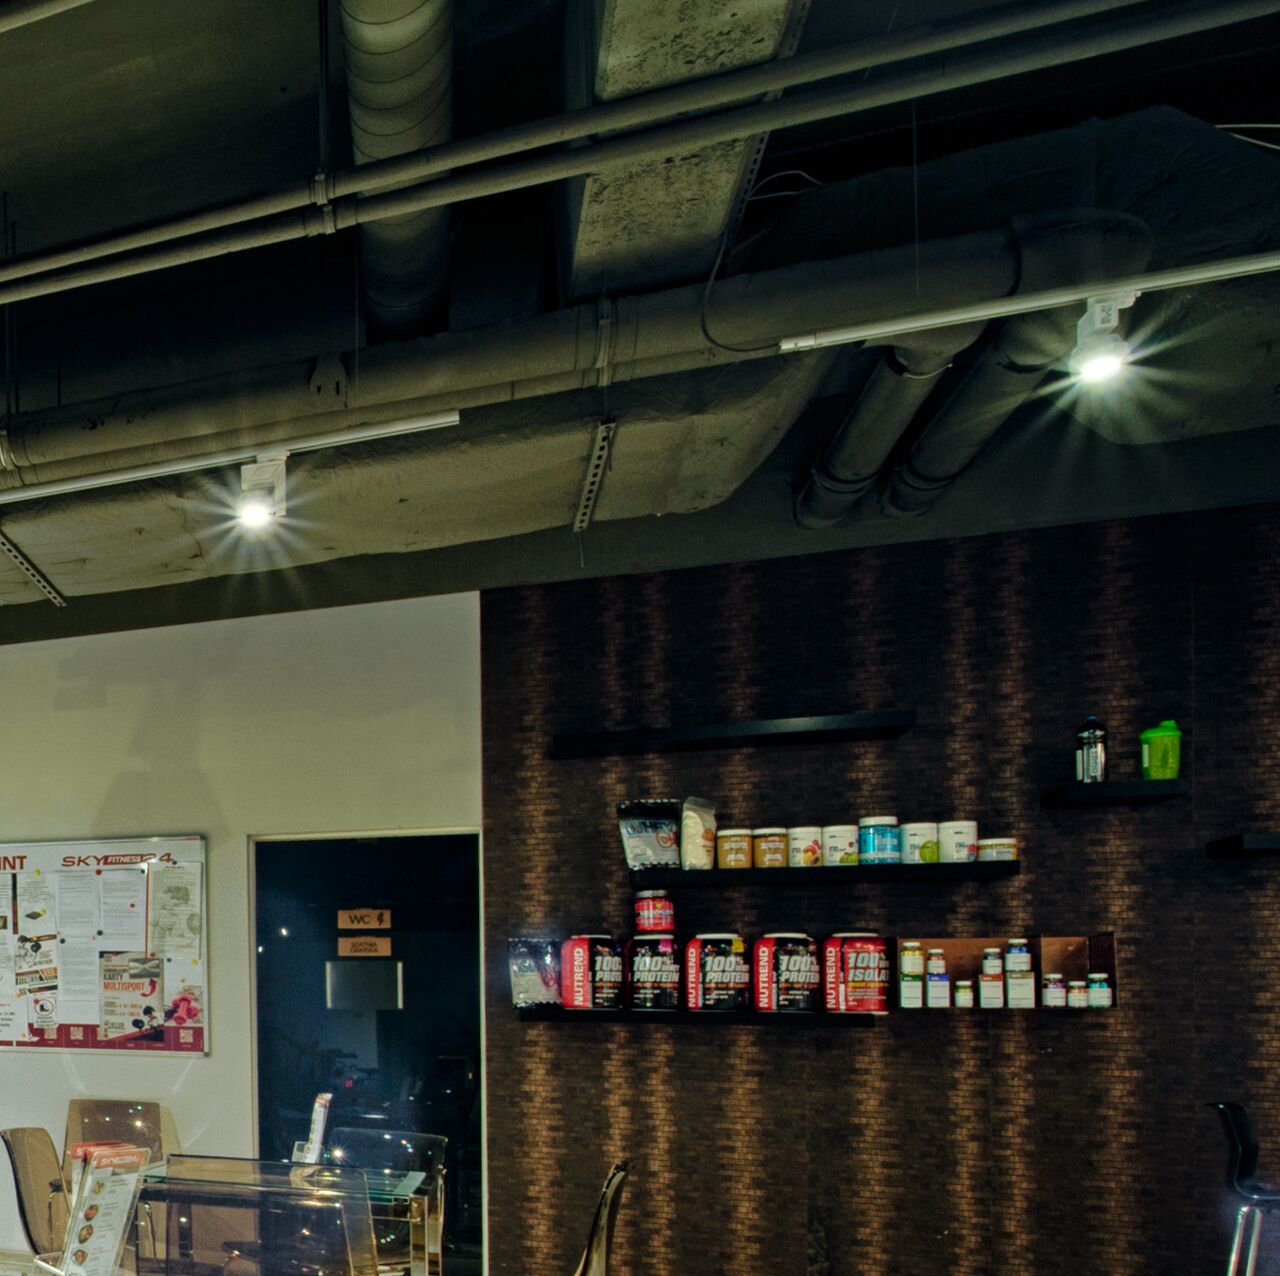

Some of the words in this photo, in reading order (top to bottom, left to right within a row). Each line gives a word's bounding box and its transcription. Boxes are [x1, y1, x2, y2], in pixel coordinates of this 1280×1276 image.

[349, 914, 371, 925] WC
[103, 981, 145, 992] MULTISPORT
[574, 947, 584, 1006] NUTREND
[633, 971, 680, 982] PROTEIN
[688, 948, 696, 1008] NUTREND
[706, 972, 750, 983] PROTEIN
[759, 947, 769, 1008] NUTREND
[826, 947, 835, 1008] NUTREND
